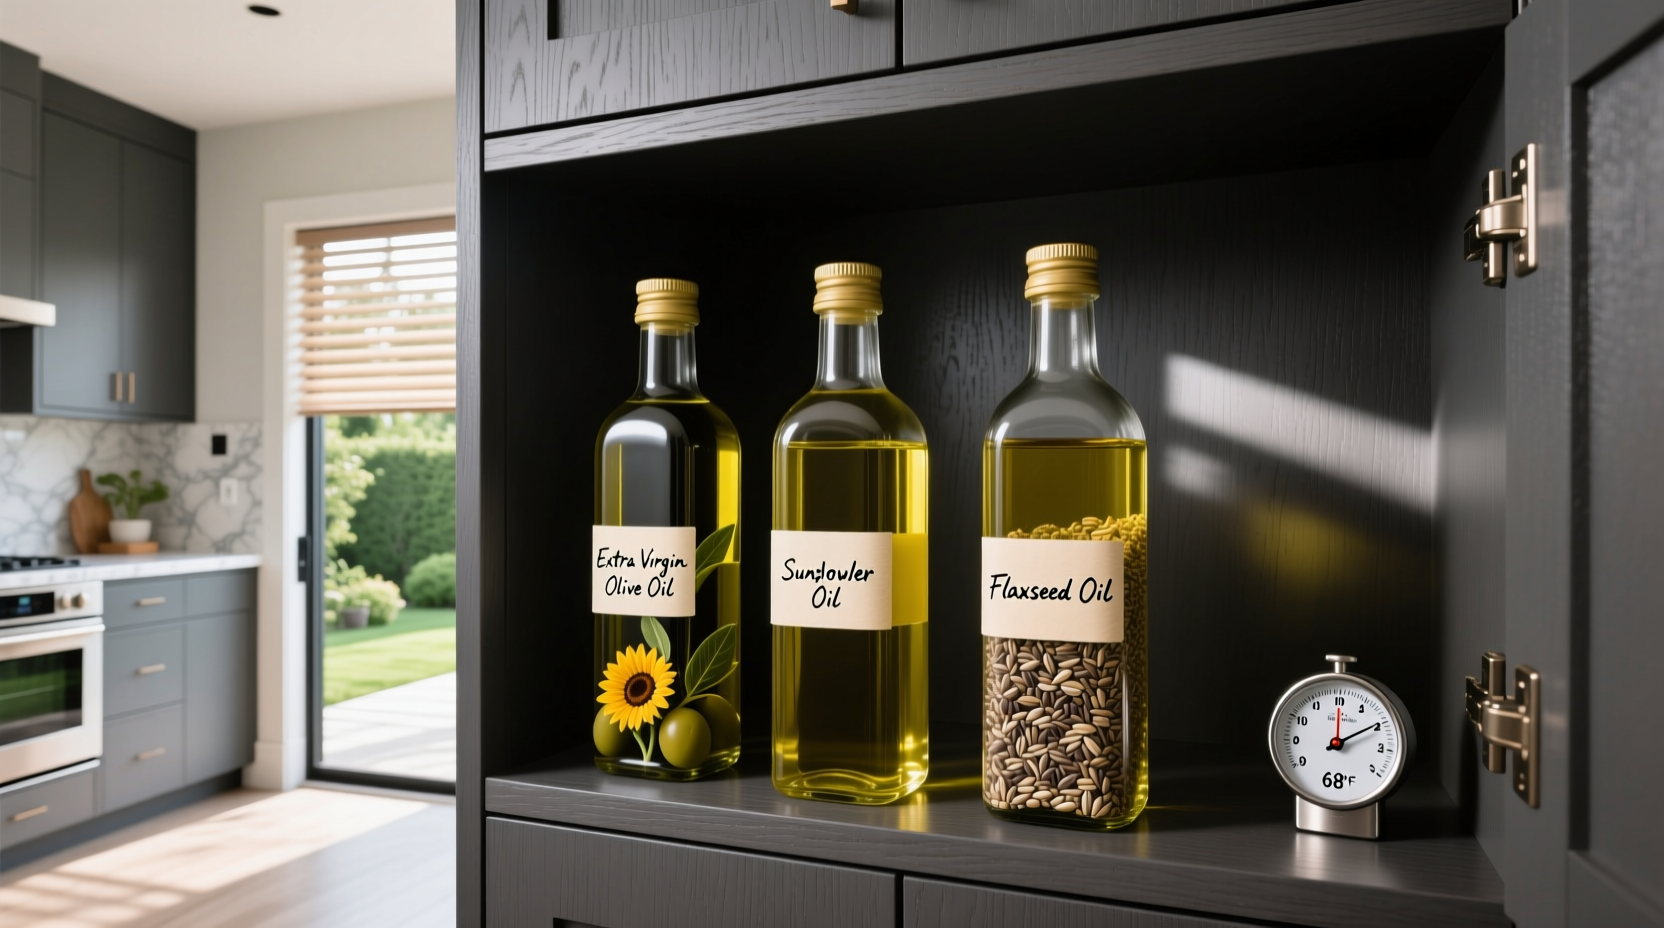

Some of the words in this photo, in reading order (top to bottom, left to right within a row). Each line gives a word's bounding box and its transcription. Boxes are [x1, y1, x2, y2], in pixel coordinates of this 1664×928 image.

[597, 547, 635, 568] Extra
[641, 547, 688, 578] Virgin
[605, 575, 642, 597] Olive
[648, 576, 675, 598] Oil
[811, 585, 841, 609] Oil
[990, 573, 1073, 601] Flaxseed
[1079, 577, 1113, 604] Oil
